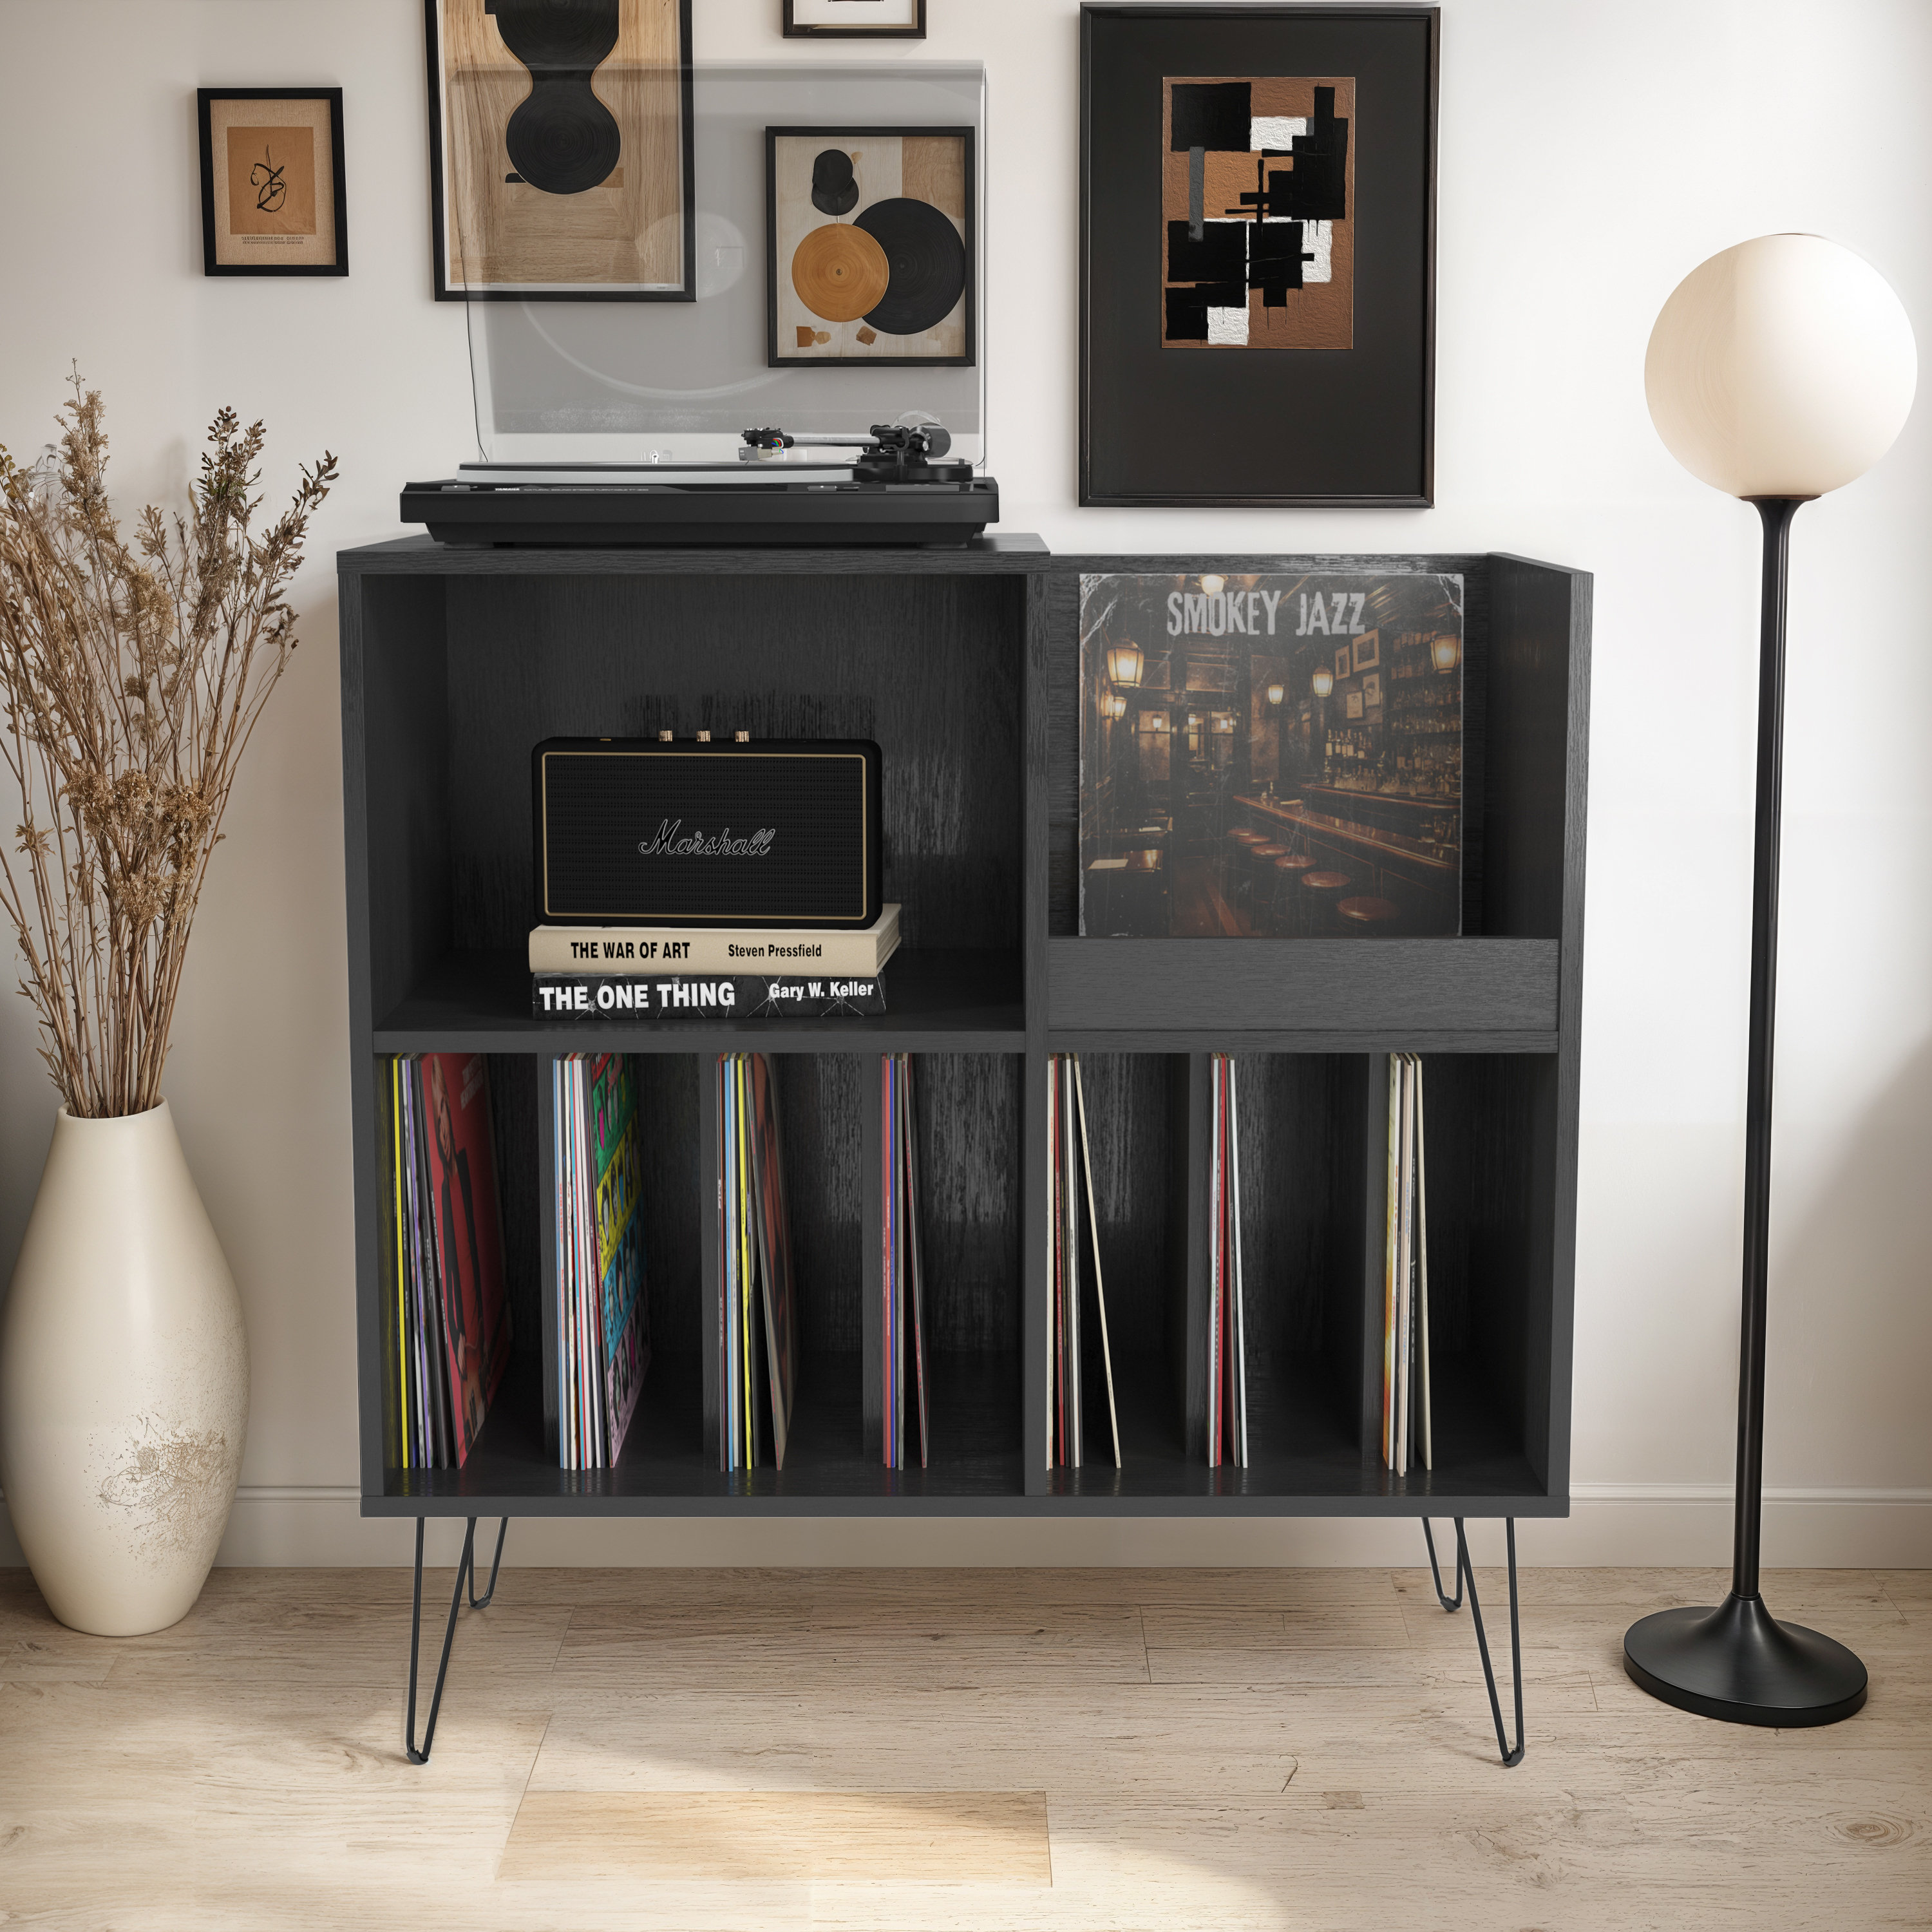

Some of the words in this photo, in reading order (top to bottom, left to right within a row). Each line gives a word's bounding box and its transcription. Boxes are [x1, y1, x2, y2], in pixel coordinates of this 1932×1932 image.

[1166, 591, 1281, 636] SMOKEY
[1296, 592, 1366, 636] JAZZ
[638, 819, 776, 856] Marshall
[571, 942, 599, 958] THE
[603, 942, 634, 958] WAR
[639, 942, 658, 959] OF
[663, 942, 690, 959] ART
[728, 943, 764, 957] Steven
[768, 943, 822, 957] Pressfield
[539, 986, 587, 1010] THE
[597, 985, 649, 1009] ONE
[656, 981, 735, 1008] THING
[770, 983, 804, 1001] Gary
[808, 983, 825, 998] W.
[829, 981, 874, 998] Keller
